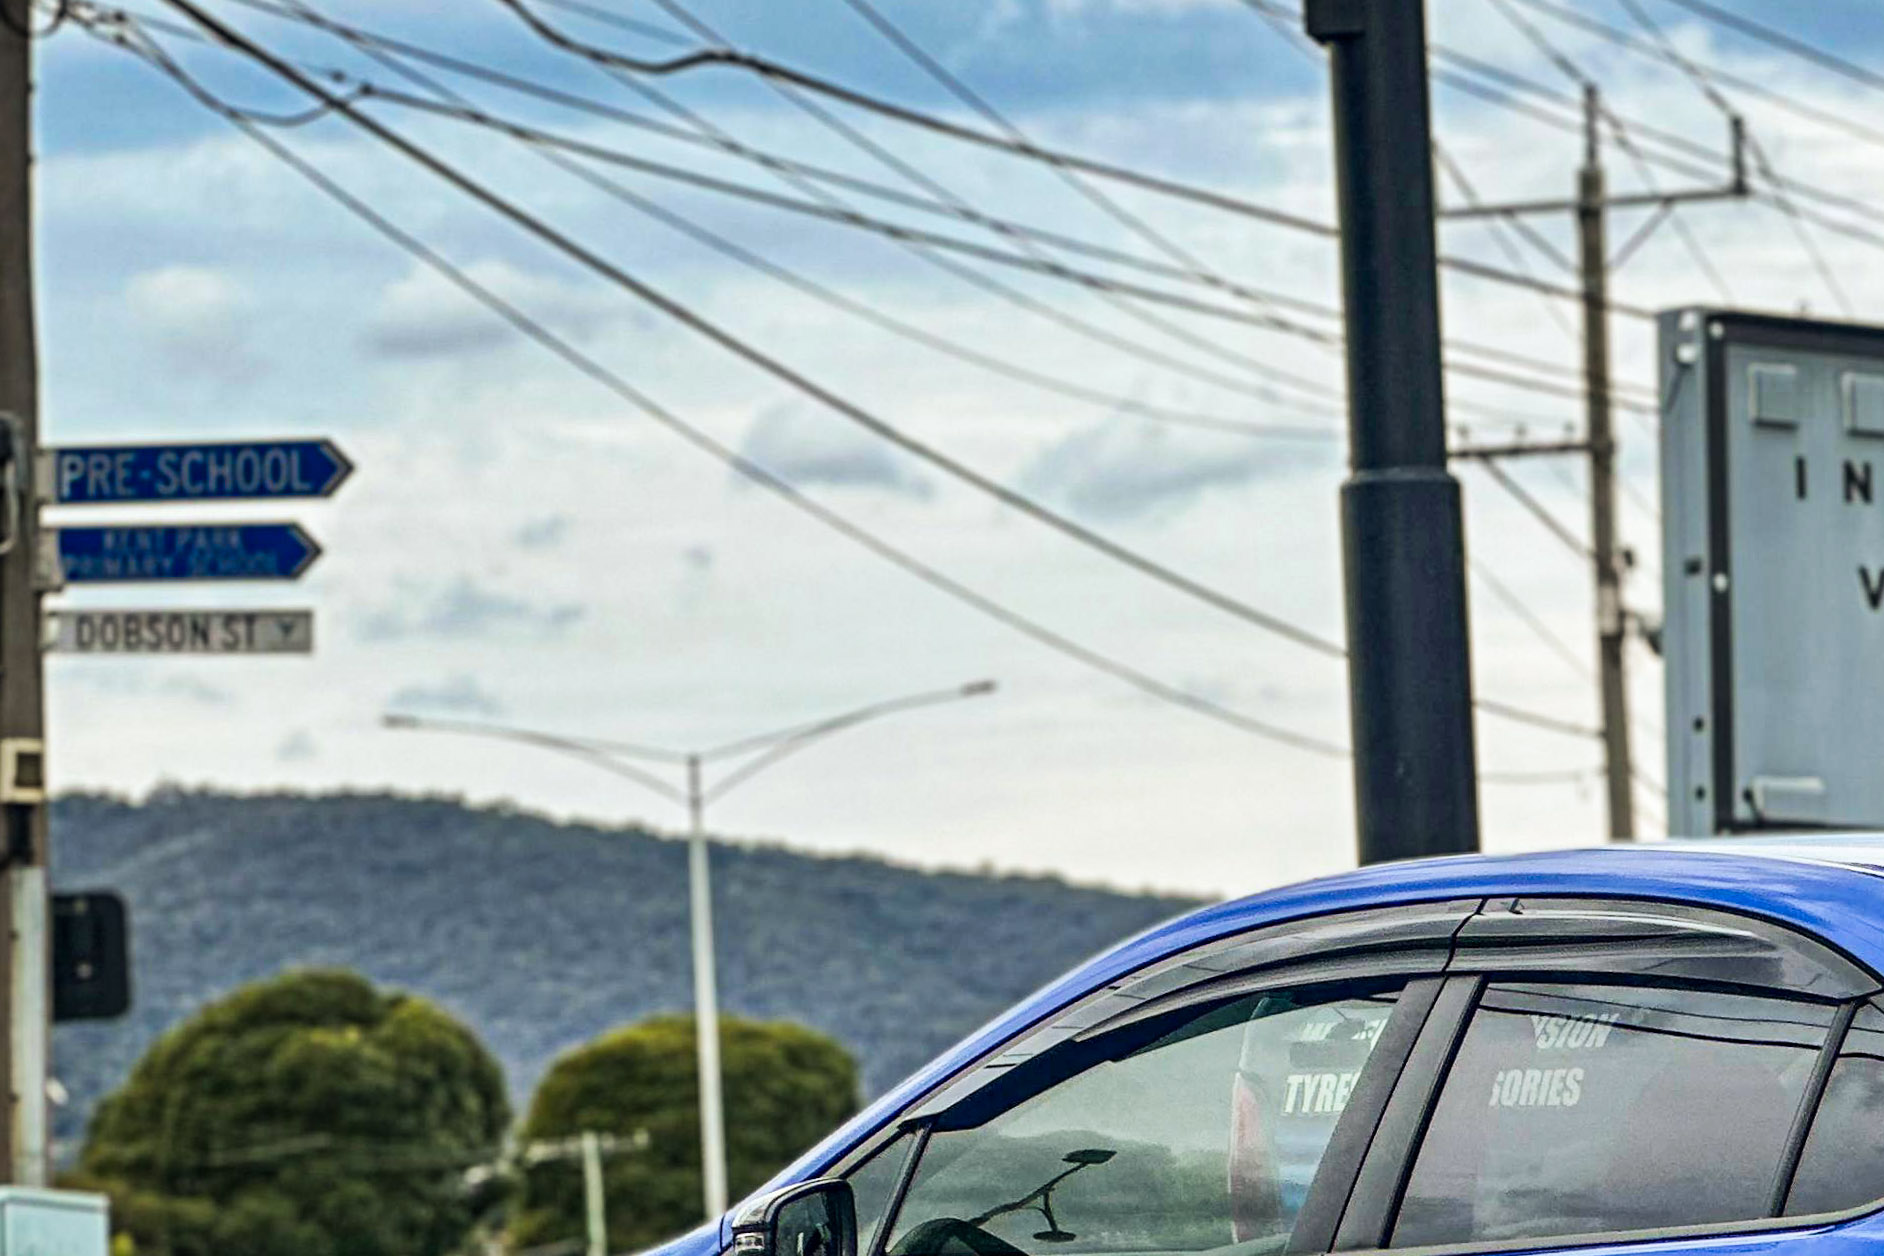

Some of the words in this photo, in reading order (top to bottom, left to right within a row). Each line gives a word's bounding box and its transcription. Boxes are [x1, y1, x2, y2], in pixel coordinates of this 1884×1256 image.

[61, 448, 311, 498] PRE-SCHOOL
[76, 614, 210, 650] DOBSON
[222, 614, 256, 650] ST
